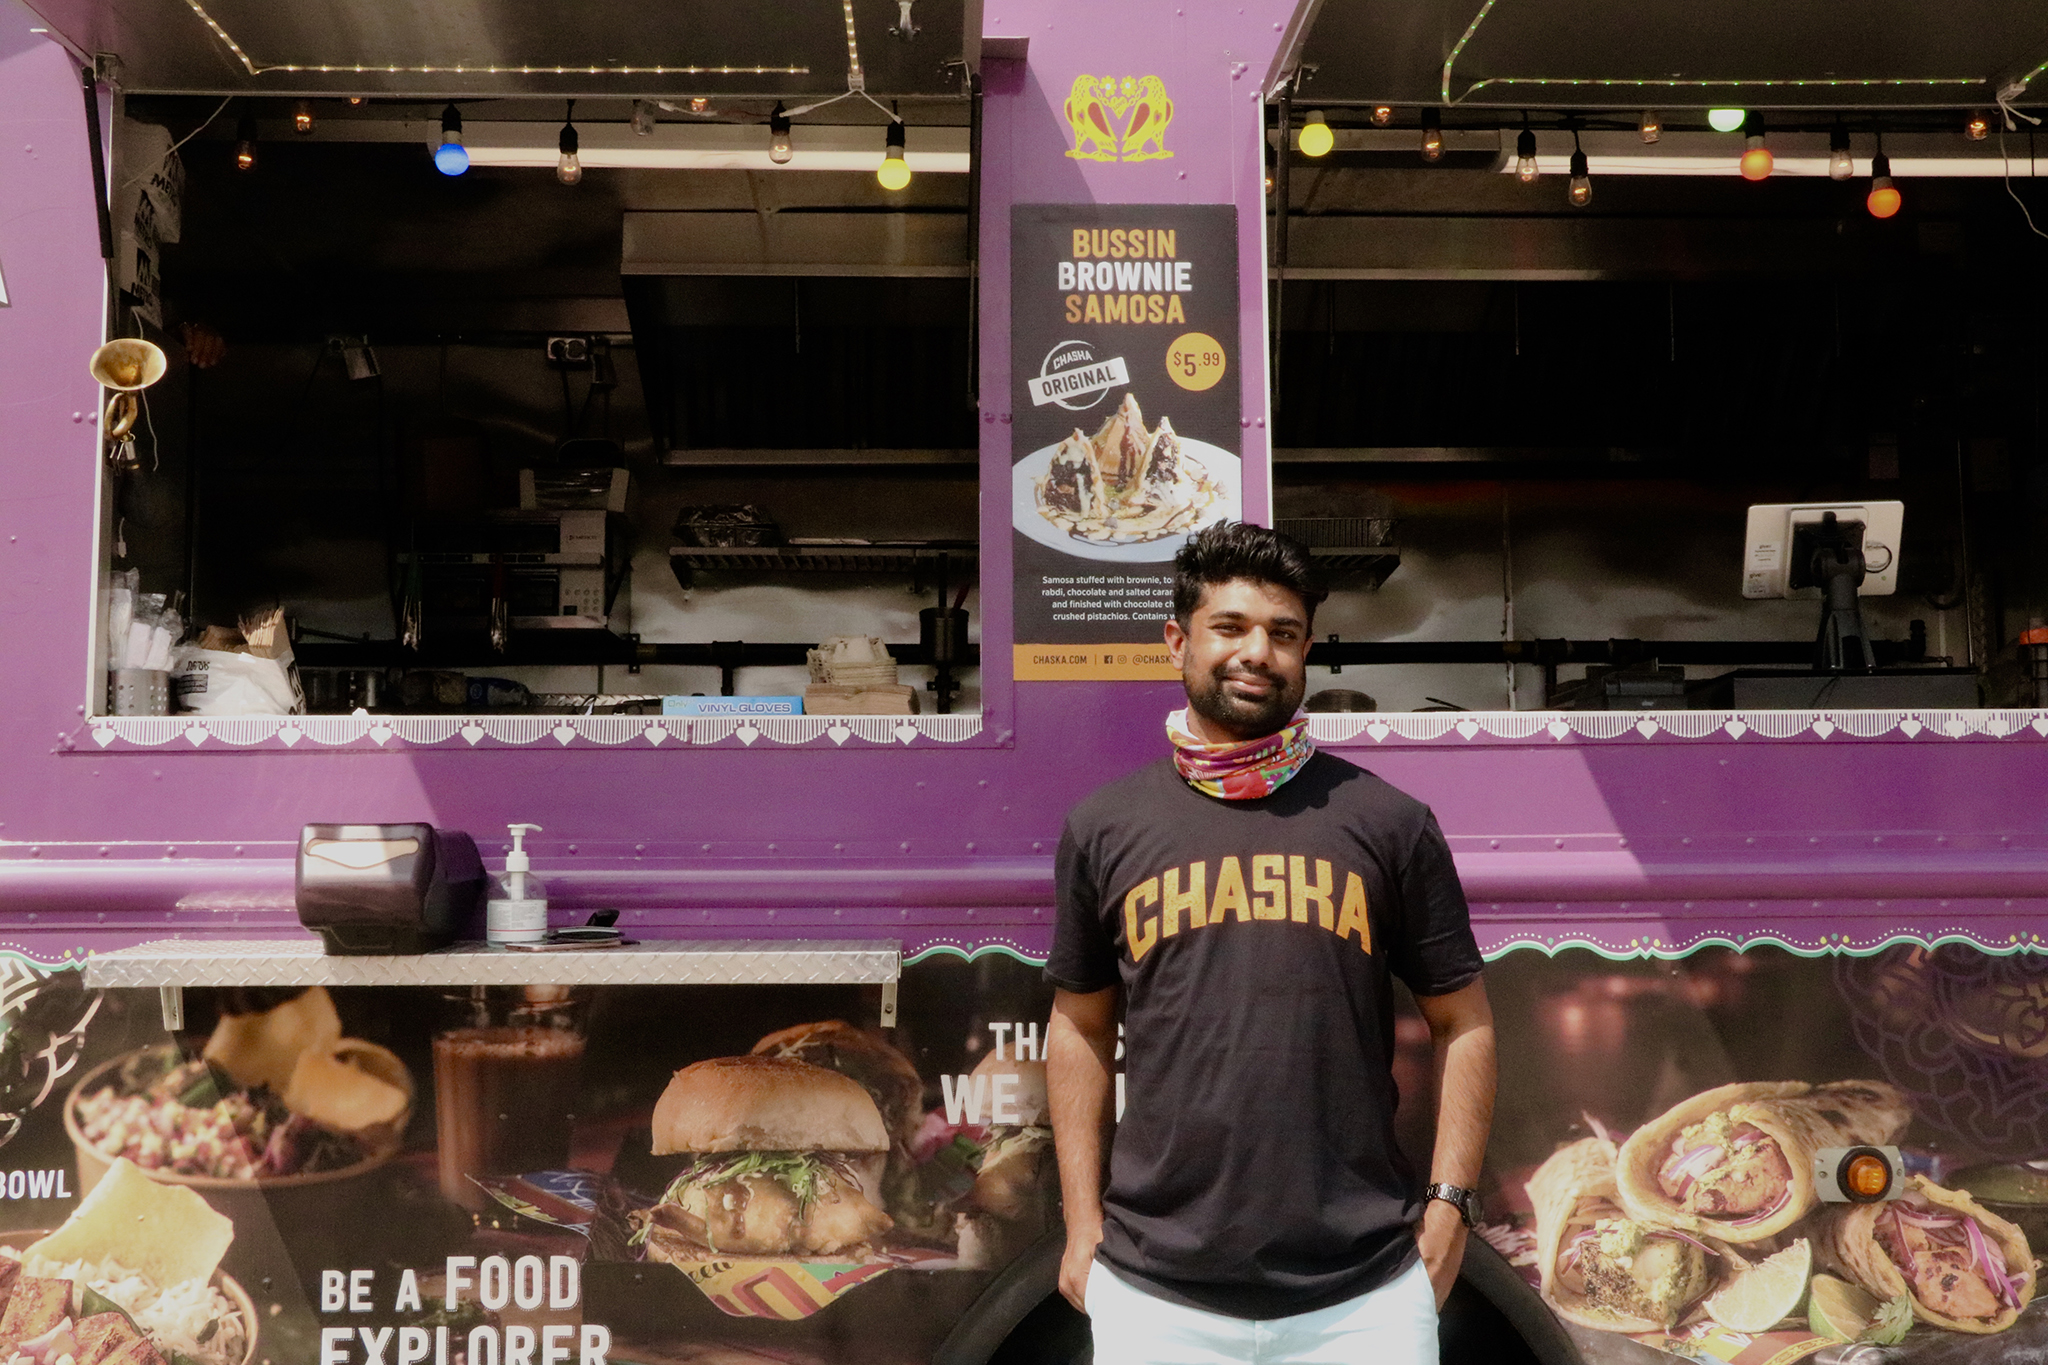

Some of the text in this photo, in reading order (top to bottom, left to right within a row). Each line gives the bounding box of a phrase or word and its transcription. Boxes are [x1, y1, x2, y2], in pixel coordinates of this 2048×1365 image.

[1073, 229, 1176, 258] BUSSIN
[1058, 262, 1192, 291] BROWNIE
[1065, 294, 1186, 324] SAMOSA
[1174, 351, 1219, 377] $5.99
[1042, 366, 1116, 397] ORIGINAL
[1042, 576, 1074, 584] Samosa
[1076, 576, 1105, 584] stuffed
[1106, 576, 1125, 584] with
[1126, 576, 1162, 585] brownie,
[1042, 588, 1065, 597] rabdi,
[1067, 588, 1107, 596] chocolate
[1108, 588, 1124, 596] and
[1126, 588, 1150, 596] salted
[1052, 600, 1068, 608] and
[1069, 600, 1102, 608] finished
[1104, 600, 1121, 608] with
[1123, 600, 1163, 608] chocolate
[1053, 612, 1086, 620] crushed
[1087, 612, 1130, 621] pistachios.
[1132, 612, 1168, 620] Contains
[1033, 654, 1172, 666] CHASKA.COM @CHASK
[698, 703, 791, 713] VINYL GLOVES
[1124, 854, 1371, 962] CHASKA
[940, 1074, 1020, 1126] WE
[321, 1254, 582, 1313] BE A FOOD
[320, 1324, 613, 1365] EXPLORER
